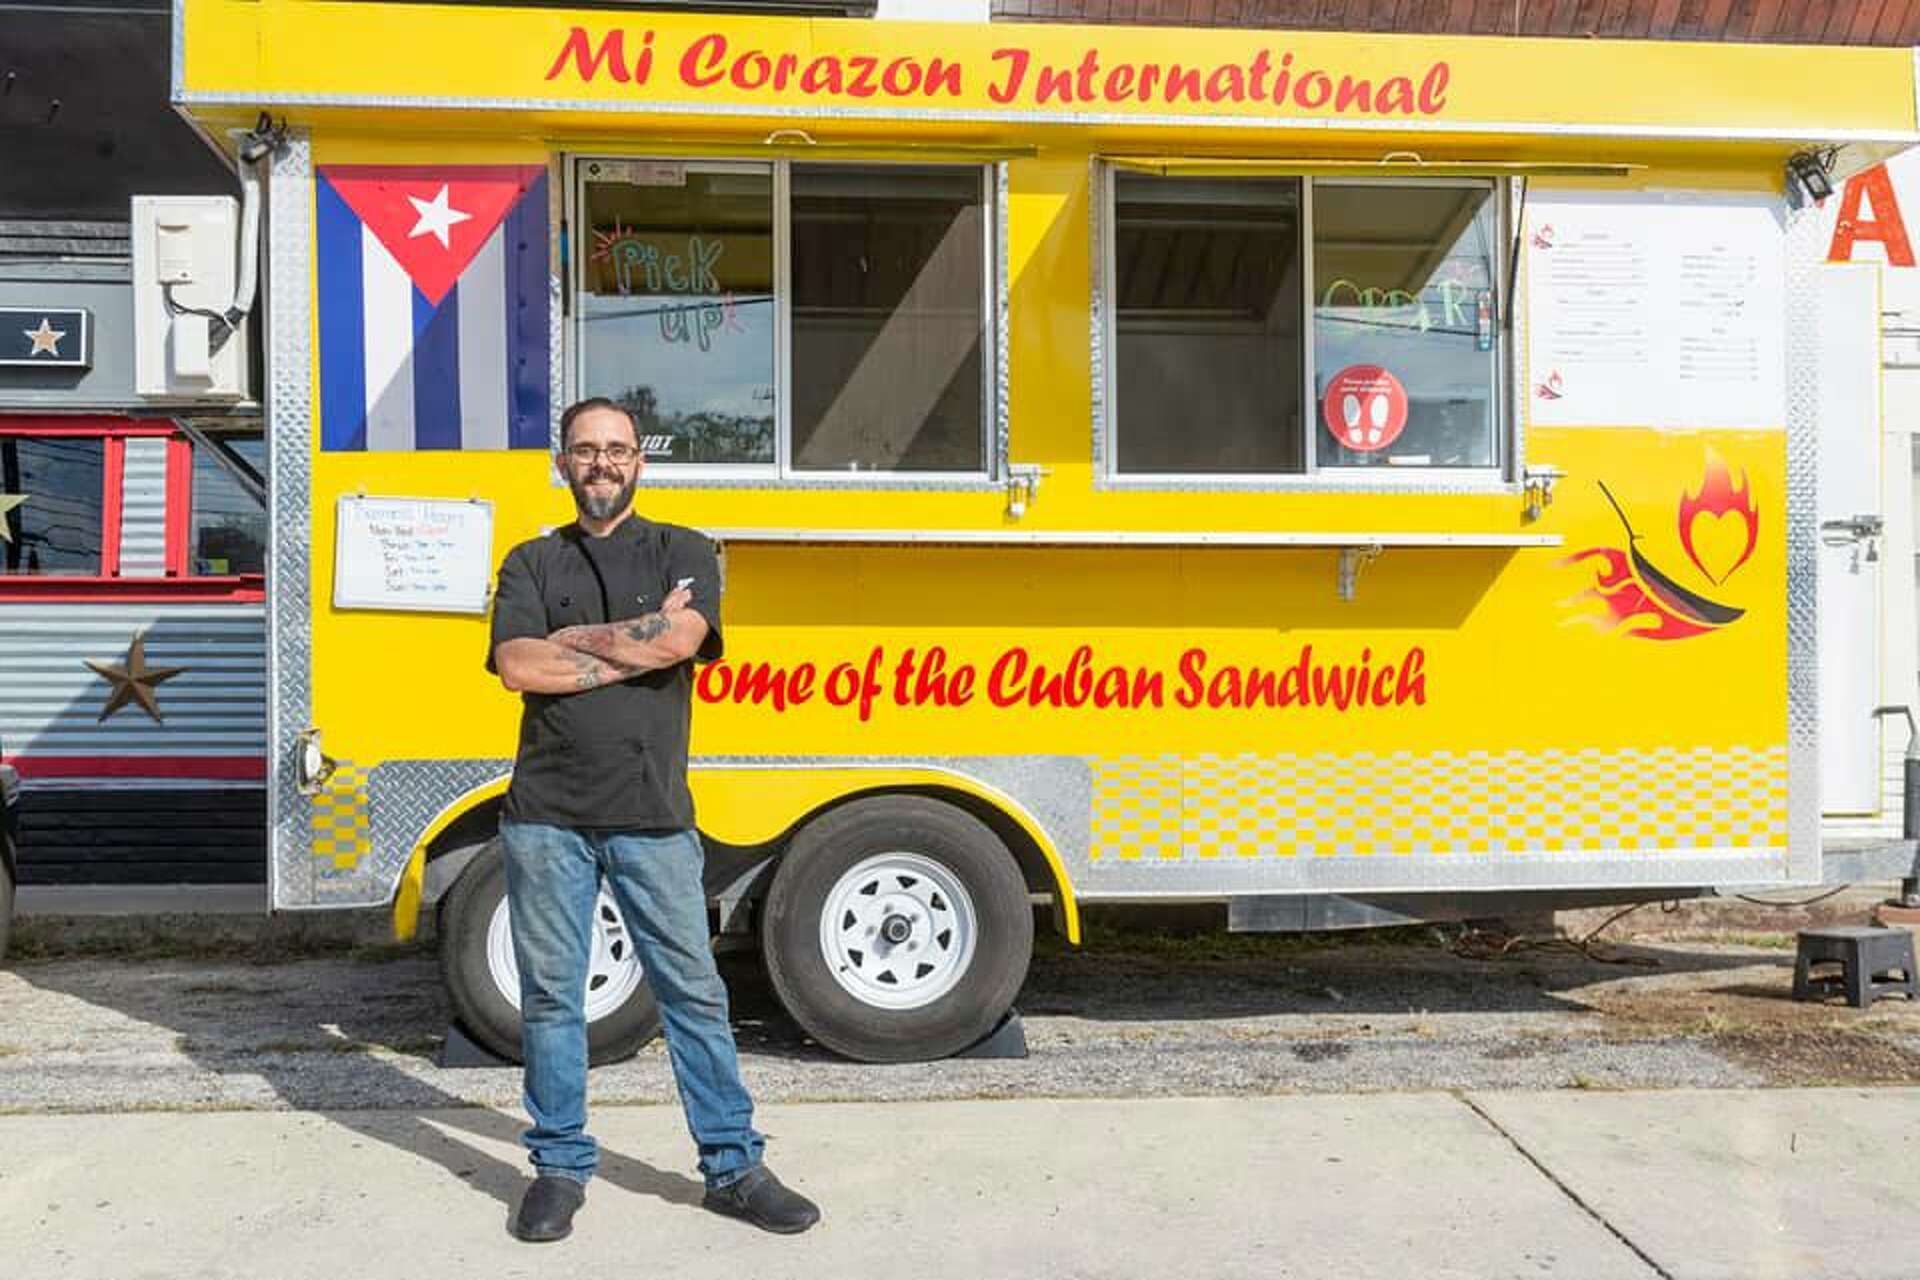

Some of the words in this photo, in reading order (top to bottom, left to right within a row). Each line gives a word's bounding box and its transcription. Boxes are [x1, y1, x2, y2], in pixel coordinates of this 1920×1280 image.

[547, 28, 654, 84] Mi
[678, 34, 963, 98] Corazon
[989, 48, 1450, 115] International
[691, 658, 816, 712] ome
[823, 645, 884, 723] of
[893, 646, 976, 708] the
[987, 646, 1164, 709] Cuban
[1175, 645, 1427, 713] Sandwich
